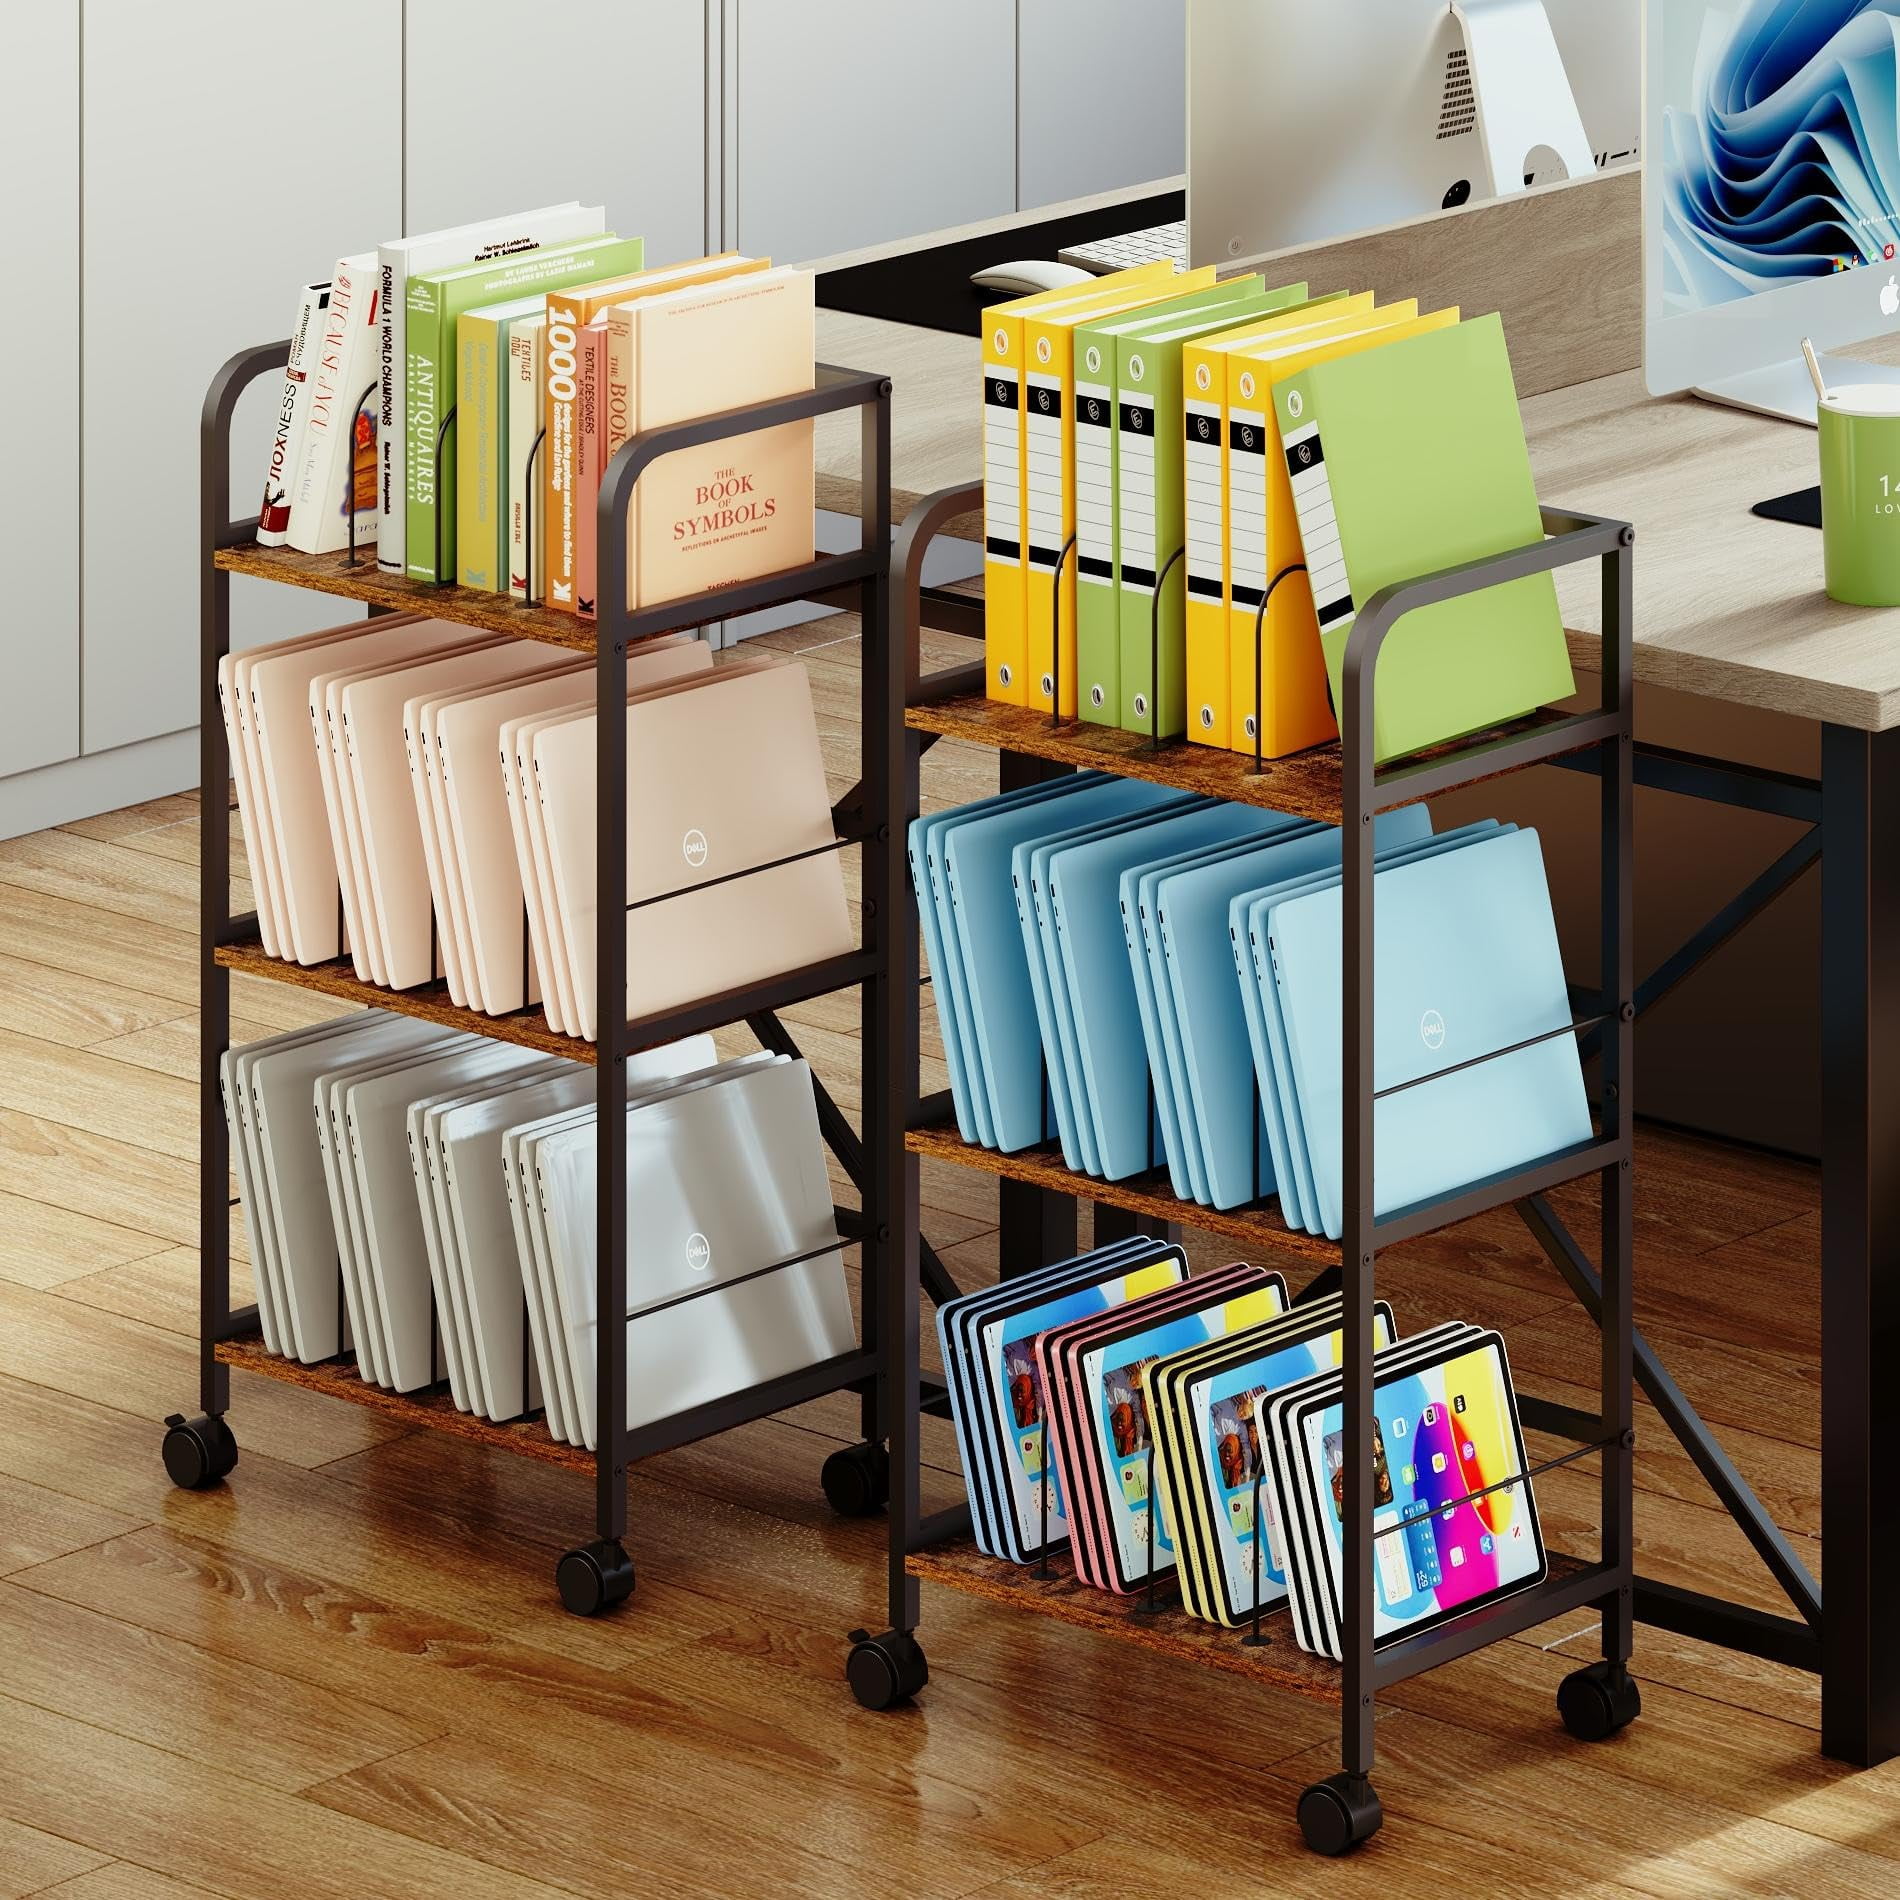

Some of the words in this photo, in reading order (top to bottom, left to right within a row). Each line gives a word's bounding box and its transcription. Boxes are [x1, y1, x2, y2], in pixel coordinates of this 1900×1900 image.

[382, 265, 393, 315] FORMULA
[382, 325, 393, 364] WORLD
[521, 340, 531, 382] TEXTILES
[548, 306, 577, 401] 1000
[585, 346, 595, 382] TEXTILE
[408, 354, 416, 393] PARIS
[382, 364, 393, 427] CHAMPIONS
[408, 401, 416, 432] FLEA
[585, 383, 595, 435] DESIGNERS
[610, 382, 627, 444] BOOK
[414, 356, 434, 505] ANTIQUAIRES
[408, 442, 416, 500] MARKETS
[696, 474, 755, 506] BOOK
[714, 467, 736, 480] THE
[673, 498, 776, 541] SYMBOLS
[718, 497, 732, 509] OF
[681, 540, 712, 552] REFLECTIONS
[750, 525, 768, 535] IMAGES
